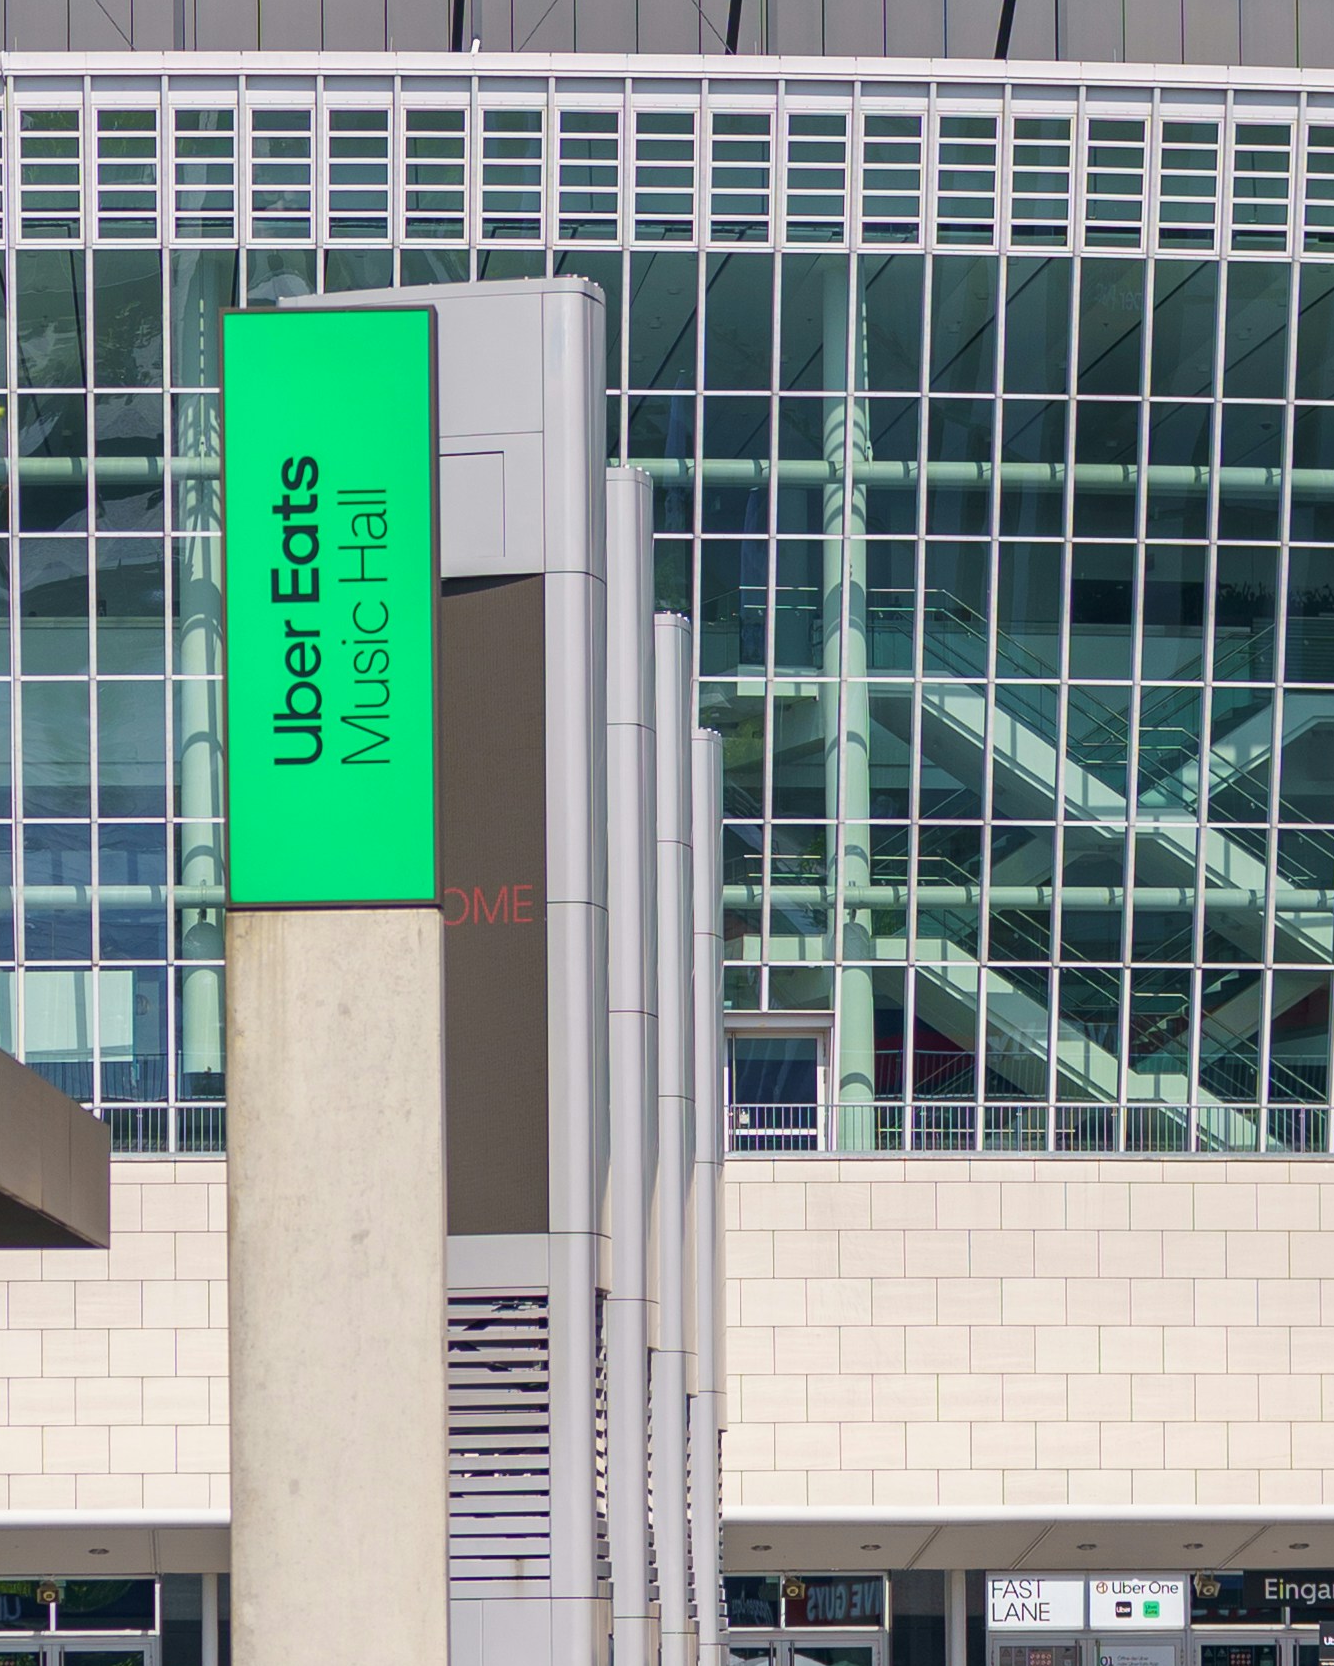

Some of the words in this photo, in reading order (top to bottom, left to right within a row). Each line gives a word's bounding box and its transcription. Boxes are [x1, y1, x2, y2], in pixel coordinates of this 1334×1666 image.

[271, 455, 320, 605] Eats
[337, 488, 388, 583] Hall
[273, 619, 322, 767] Uber
[341, 599, 391, 765] Music
[991, 1579, 1045, 1599] FAST
[992, 1602, 1051, 1622] LANE
[1112, 1581, 1145, 1594] Uber
[1149, 1580, 1179, 1594] One
[1100, 1656, 1114, 1666] 01
